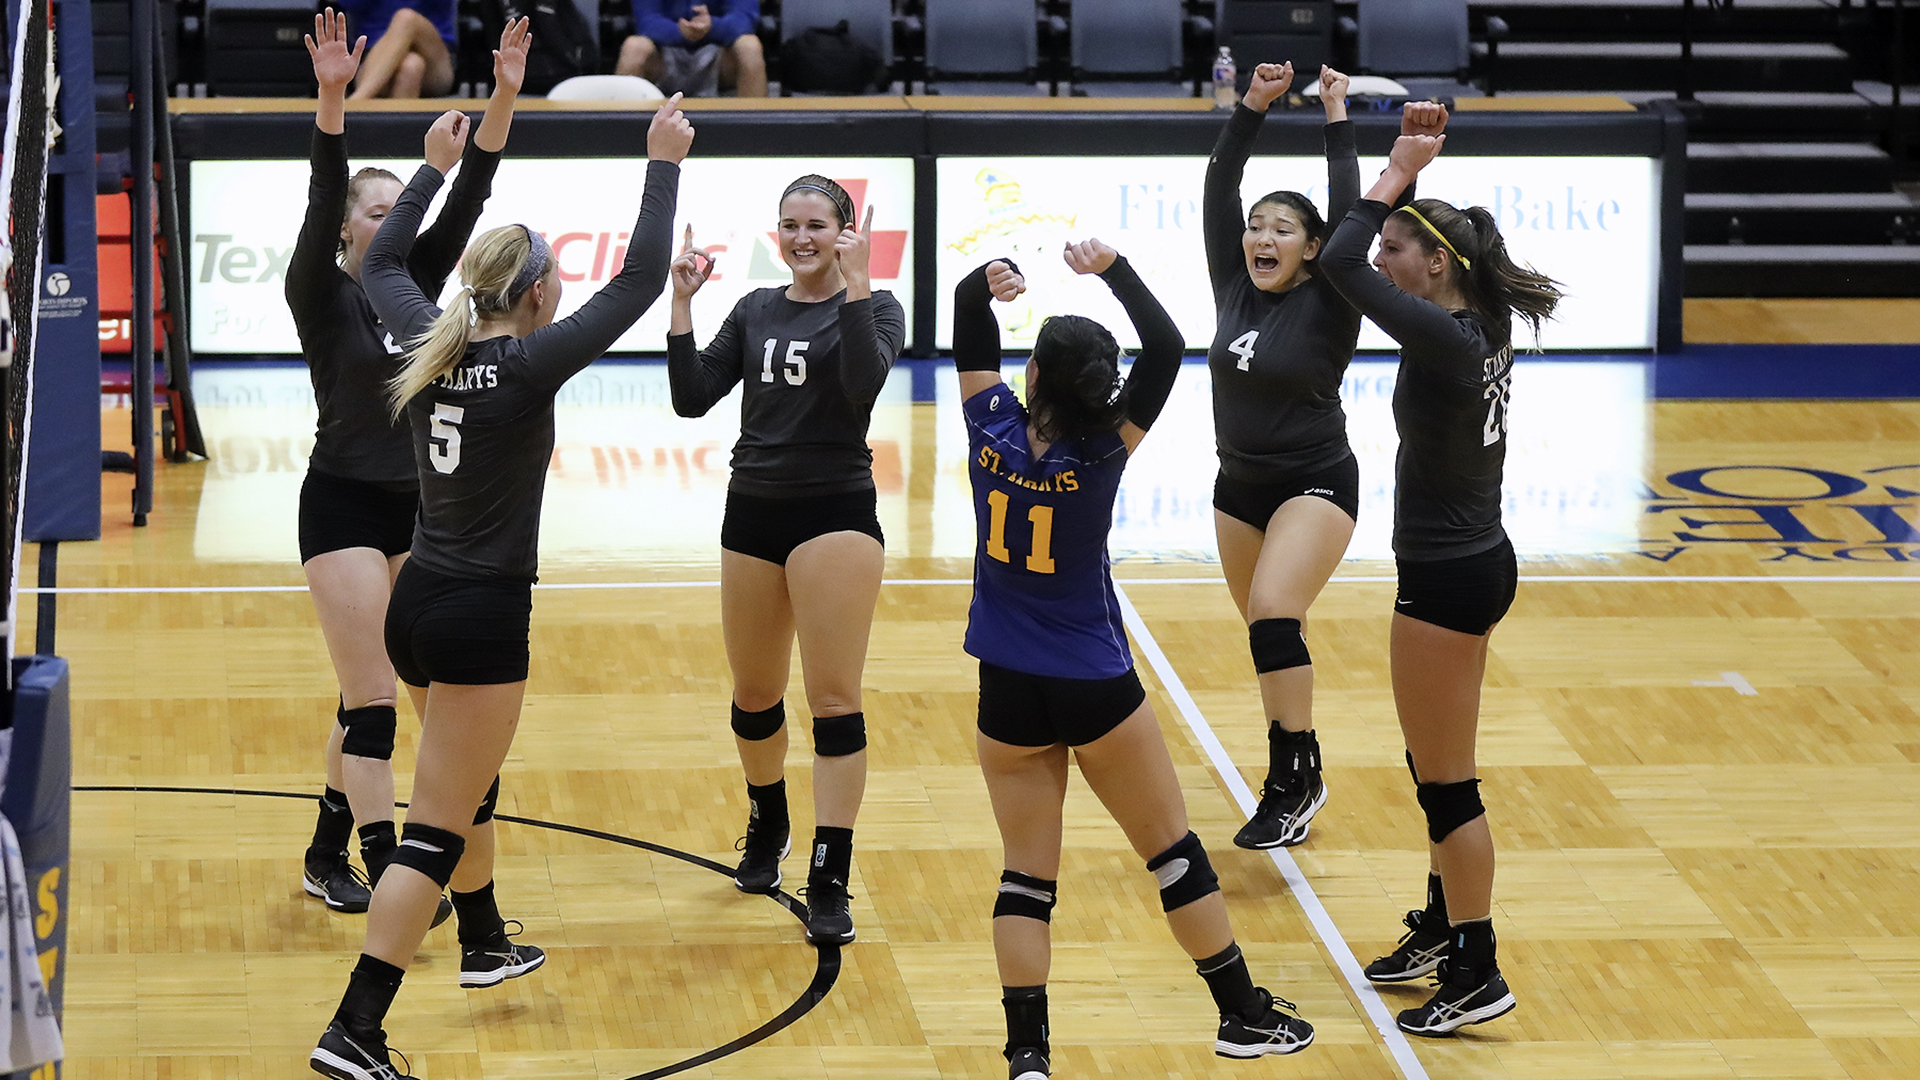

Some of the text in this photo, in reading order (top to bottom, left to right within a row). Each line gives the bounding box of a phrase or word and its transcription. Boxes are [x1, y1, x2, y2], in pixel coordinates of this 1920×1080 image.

[1493, 185, 1620, 232] Bake
[761, 338, 810, 386] 15
[1228, 329, 1260, 372] 4
[429, 402, 465, 475] 5
[986, 489, 1056, 574] 11
